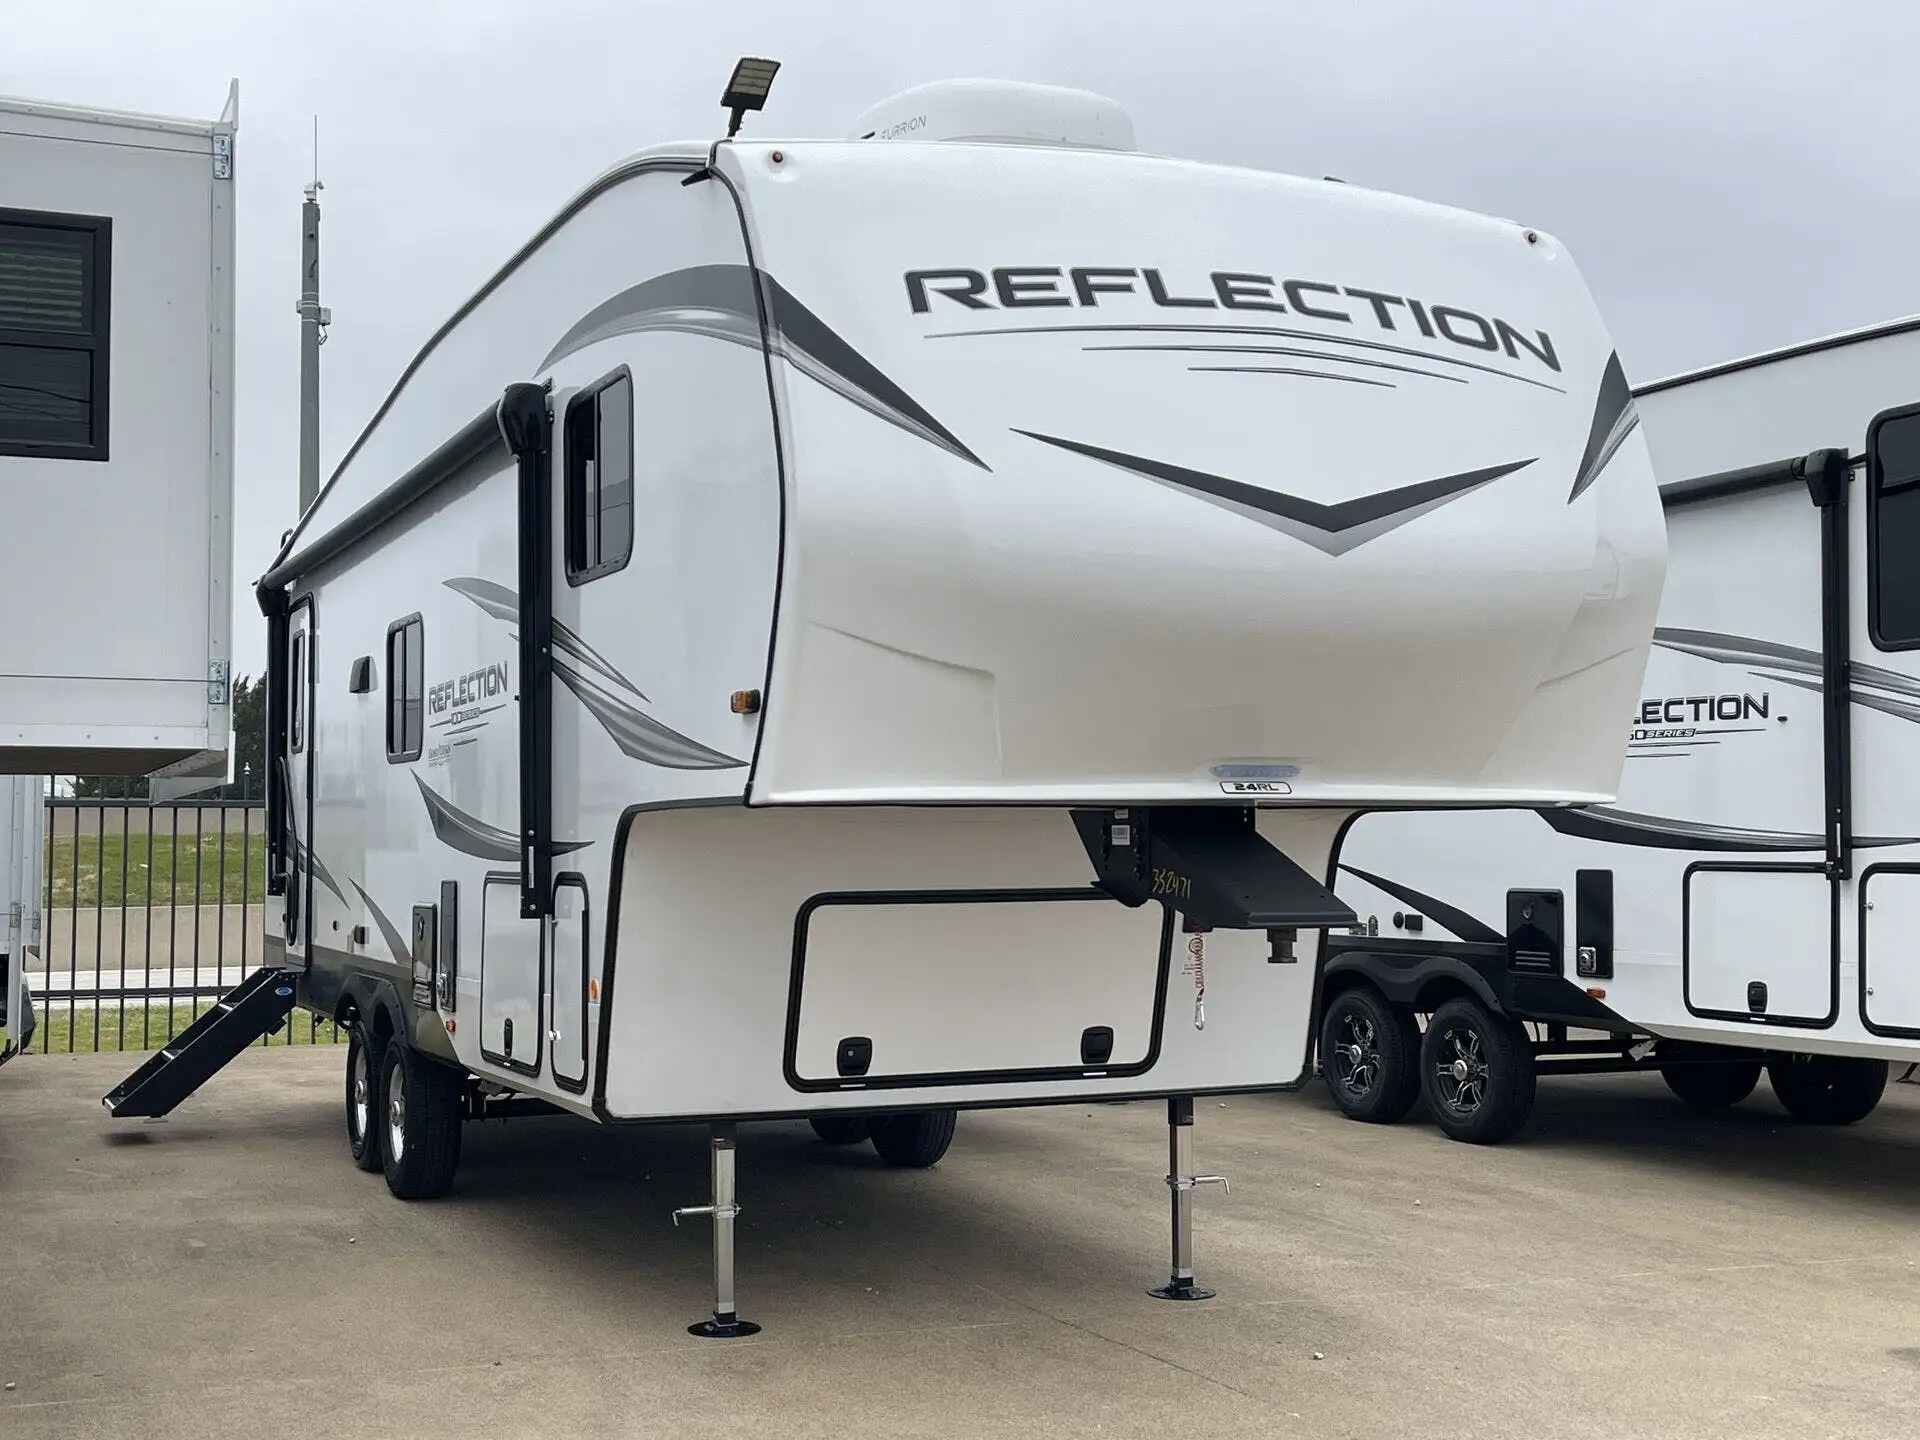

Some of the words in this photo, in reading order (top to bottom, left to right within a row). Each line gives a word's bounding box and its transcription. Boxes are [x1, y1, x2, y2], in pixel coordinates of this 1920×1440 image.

[881, 115, 927, 140] FURRION
[902, 267, 1563, 373] REFLECTION
[428, 659, 508, 715] REFLECTION
[1633, 692, 1770, 724] ECTION
[1646, 728, 1696, 739] SERIES
[1233, 783, 1280, 791] 24RL
